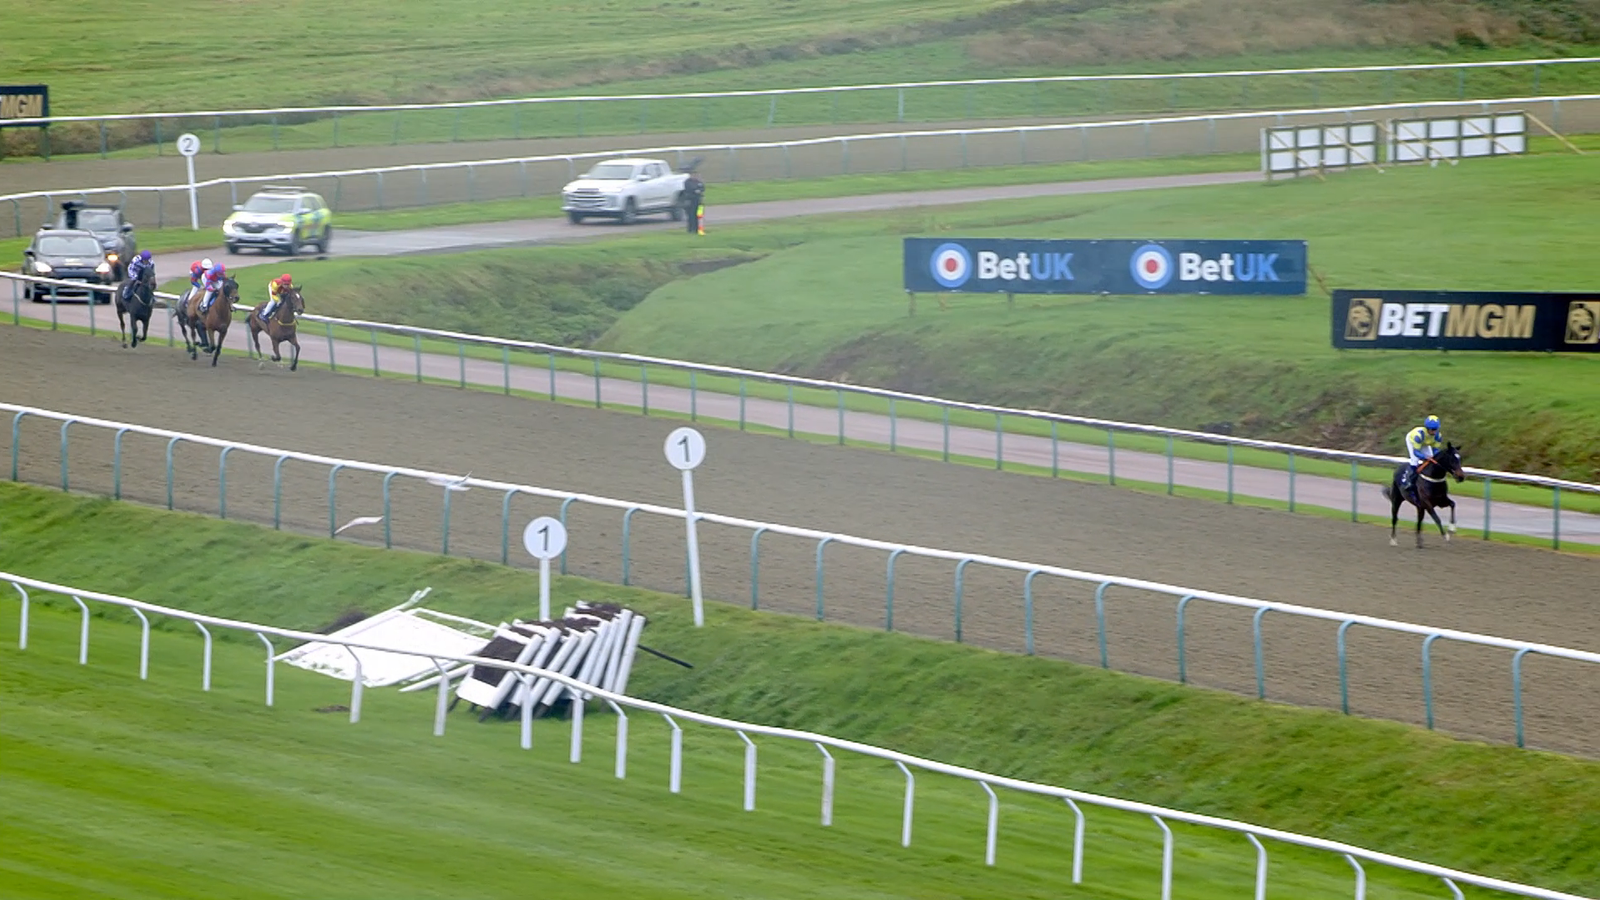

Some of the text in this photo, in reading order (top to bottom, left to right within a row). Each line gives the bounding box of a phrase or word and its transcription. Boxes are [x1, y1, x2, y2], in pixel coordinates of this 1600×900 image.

[0, 94, 43, 118] MGM
[182, 138, 193, 152] 2
[977, 251, 1075, 281] BetUK
[1179, 252, 1280, 283] BetUK
[1378, 303, 1537, 339] BETMGM
[678, 436, 690, 462] 1
[538, 525, 549, 551] 1
